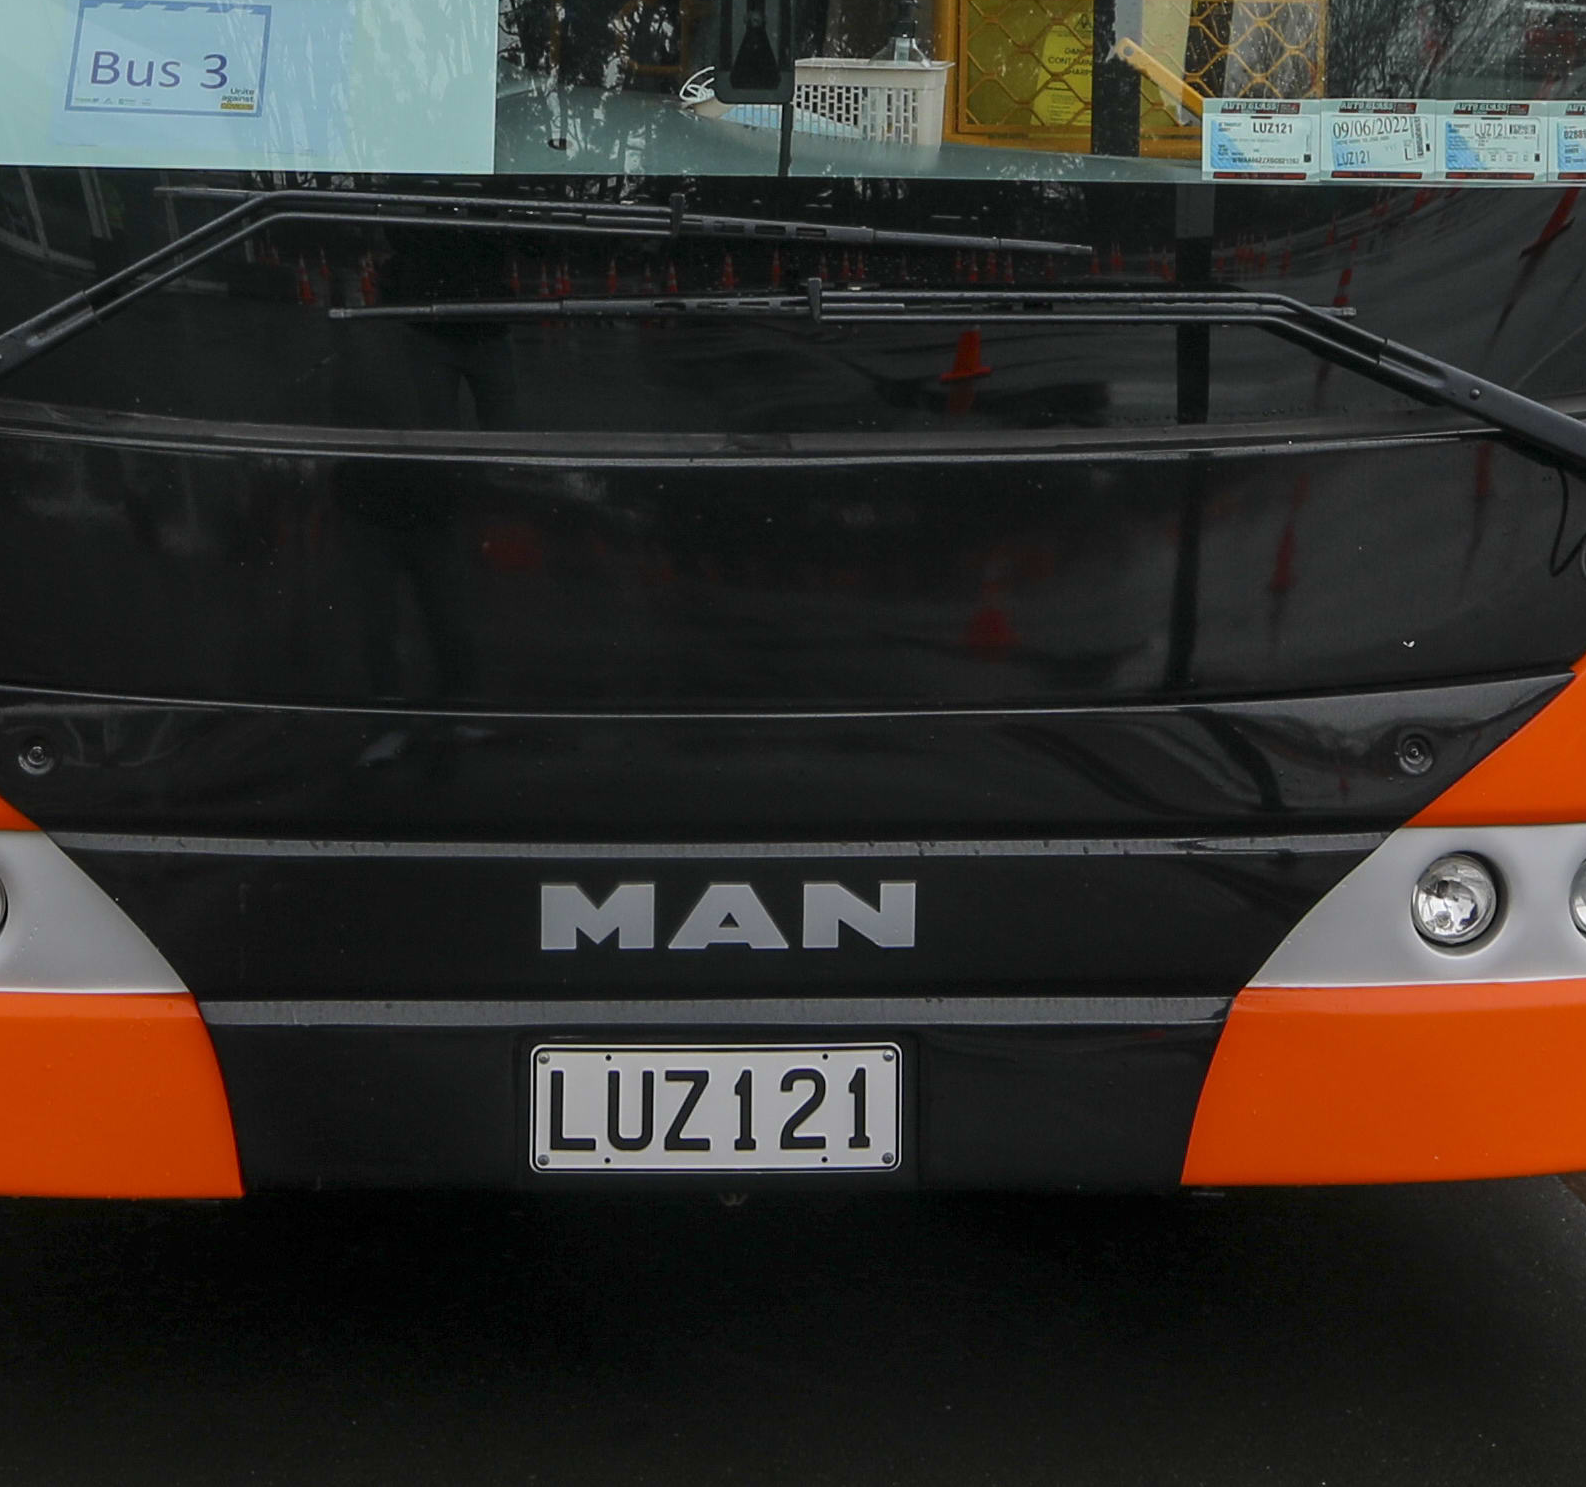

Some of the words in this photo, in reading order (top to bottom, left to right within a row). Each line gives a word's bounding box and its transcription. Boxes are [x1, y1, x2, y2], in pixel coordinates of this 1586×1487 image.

[90, 49, 183, 88] Bus
[199, 53, 230, 90] 3
[221, 95, 255, 103] against
[230, 87, 255, 96] Unite
[1252, 122, 1293, 134] LUZ121
[1332, 116, 1410, 139] 09/06/2022
[1473, 122, 1508, 137] LUZ121
[1335, 150, 1371, 167] LUZ121
[539, 880, 917, 951] MAN
[549, 1066, 872, 1152] LUZ121
